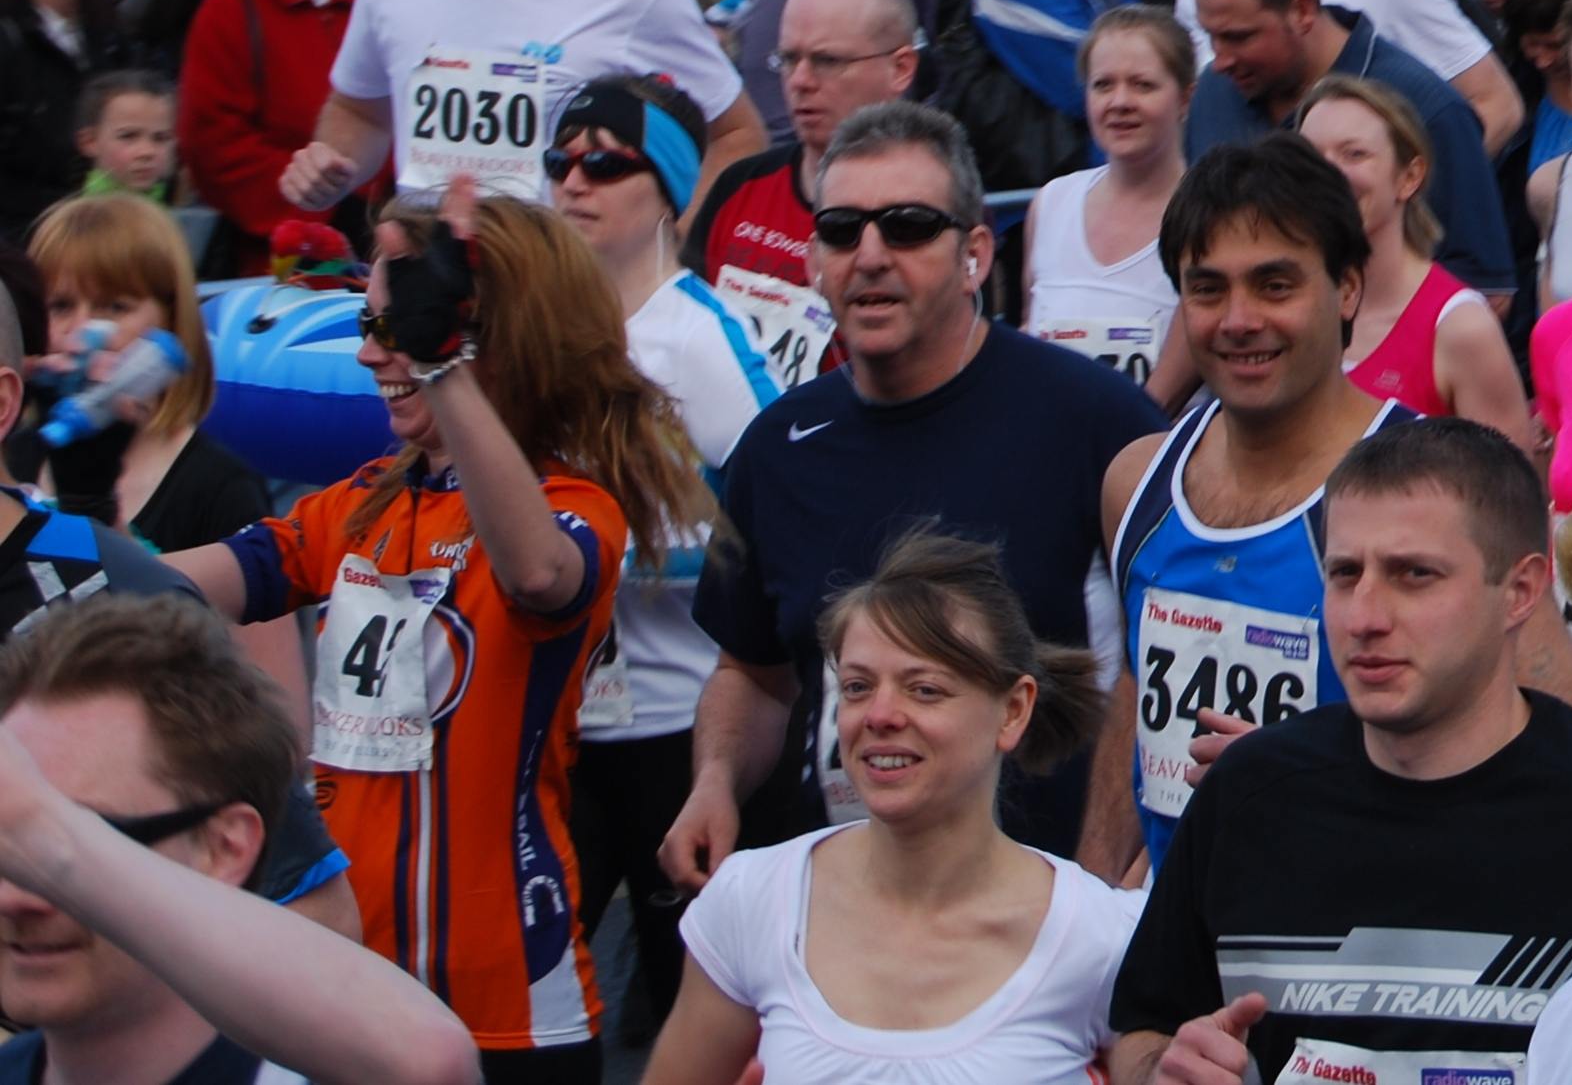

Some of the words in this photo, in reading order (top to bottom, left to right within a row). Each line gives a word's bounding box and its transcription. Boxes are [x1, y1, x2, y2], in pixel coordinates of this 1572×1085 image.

[414, 84, 537, 148] 2030
[1147, 602, 1168, 624] The
[1171, 609, 1224, 635] Gazette
[1142, 645, 1304, 738] 3486
[1278, 981, 1370, 1013] NIKE
[1371, 983, 1553, 1023] TRAINING
[1312, 1057, 1378, 1085] Gazette
[1424, 1070, 1513, 1085] radiowave
